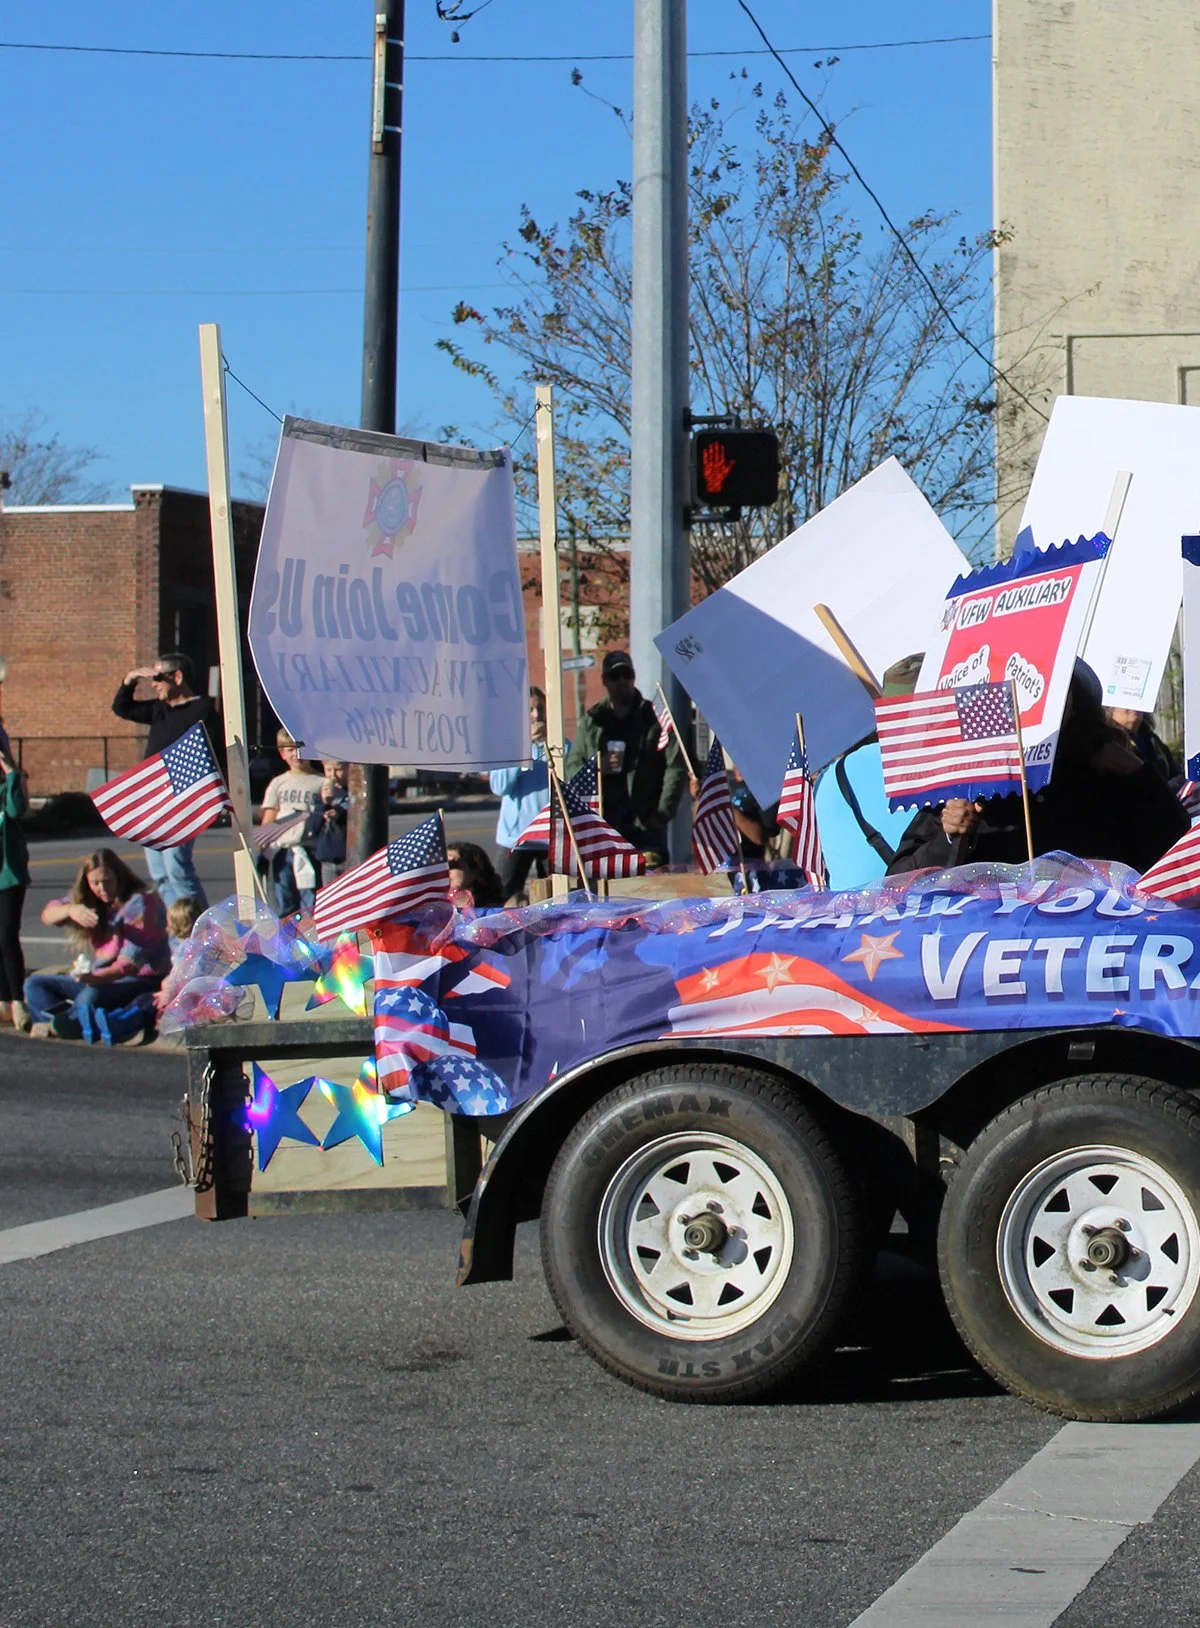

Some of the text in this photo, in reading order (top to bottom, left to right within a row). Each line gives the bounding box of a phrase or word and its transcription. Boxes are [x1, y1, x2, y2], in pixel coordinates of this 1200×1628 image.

[961, 578, 1072, 626] VFW AUXILIARY
[940, 665, 969, 690] Voice
[972, 648, 985, 670] of
[1007, 656, 1041, 698] Patriot's
[657, 1358, 722, 1379] STR
